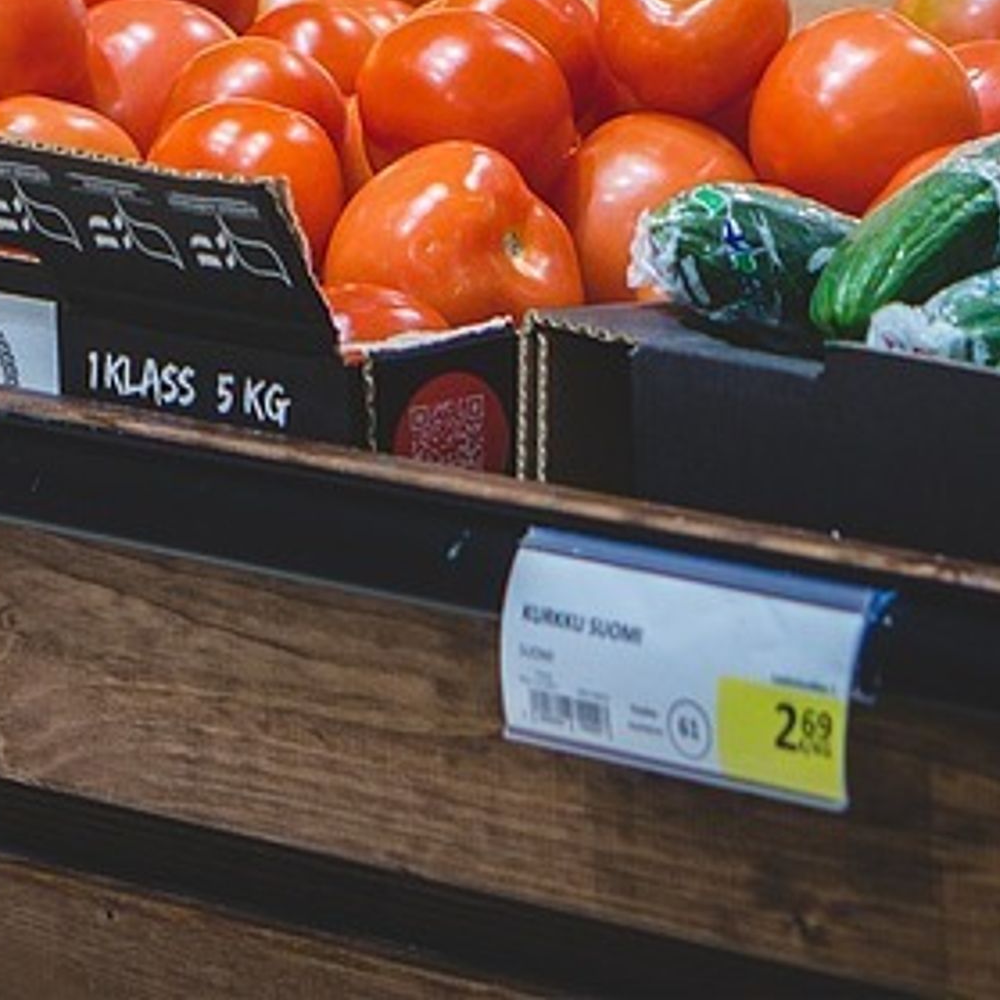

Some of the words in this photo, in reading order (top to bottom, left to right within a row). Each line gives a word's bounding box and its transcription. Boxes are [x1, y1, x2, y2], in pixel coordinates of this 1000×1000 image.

[103, 352, 196, 407] KLASS
[216, 372, 235, 415] 5
[242, 374, 292, 428] KG
[588, 615, 645, 647] SUOMI
